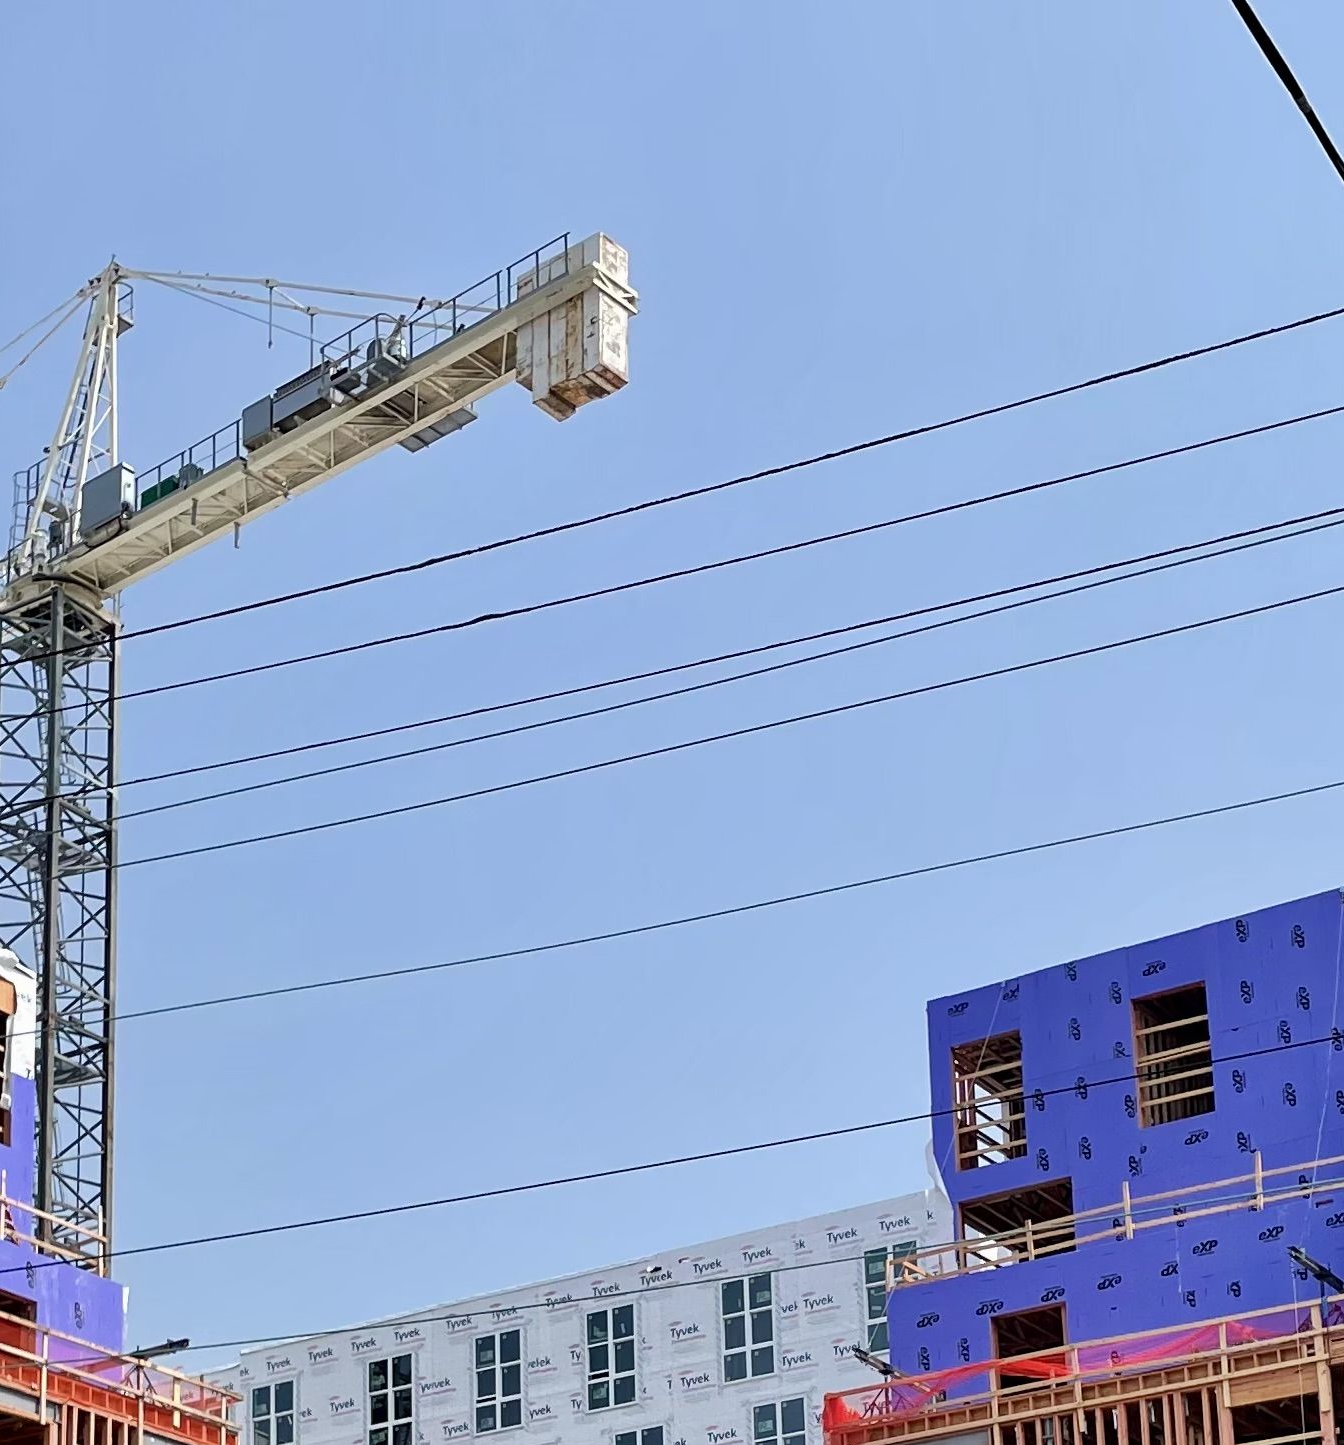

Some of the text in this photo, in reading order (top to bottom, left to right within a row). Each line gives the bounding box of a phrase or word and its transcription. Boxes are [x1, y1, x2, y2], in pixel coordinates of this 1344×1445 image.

[880, 1216, 910, 1231] Tyvek
[827, 1228, 857, 1243] Tyvek
[743, 1248, 771, 1261] Tyvek
[693, 1260, 722, 1274] Tyvek
[593, 1284, 620, 1296] Tyvek
[803, 1295, 834, 1309] Tyvek
[446, 1316, 472, 1329] Tyvek
[395, 1329, 419, 1341] Tyvek
[670, 1324, 699, 1338] Tyvek
[351, 1338, 376, 1351] Tyvek
[309, 1349, 333, 1361] Tyvek
[782, 1352, 812, 1366] Tyvek
[267, 1359, 291, 1371] Tyvek
[681, 1373, 709, 1387] Tyvek
[330, 1399, 354, 1412] Tyvek
[530, 1405, 551, 1419] yvek
[443, 1423, 469, 1435] Tyvek
[708, 1429, 737, 1442] Tyvek
